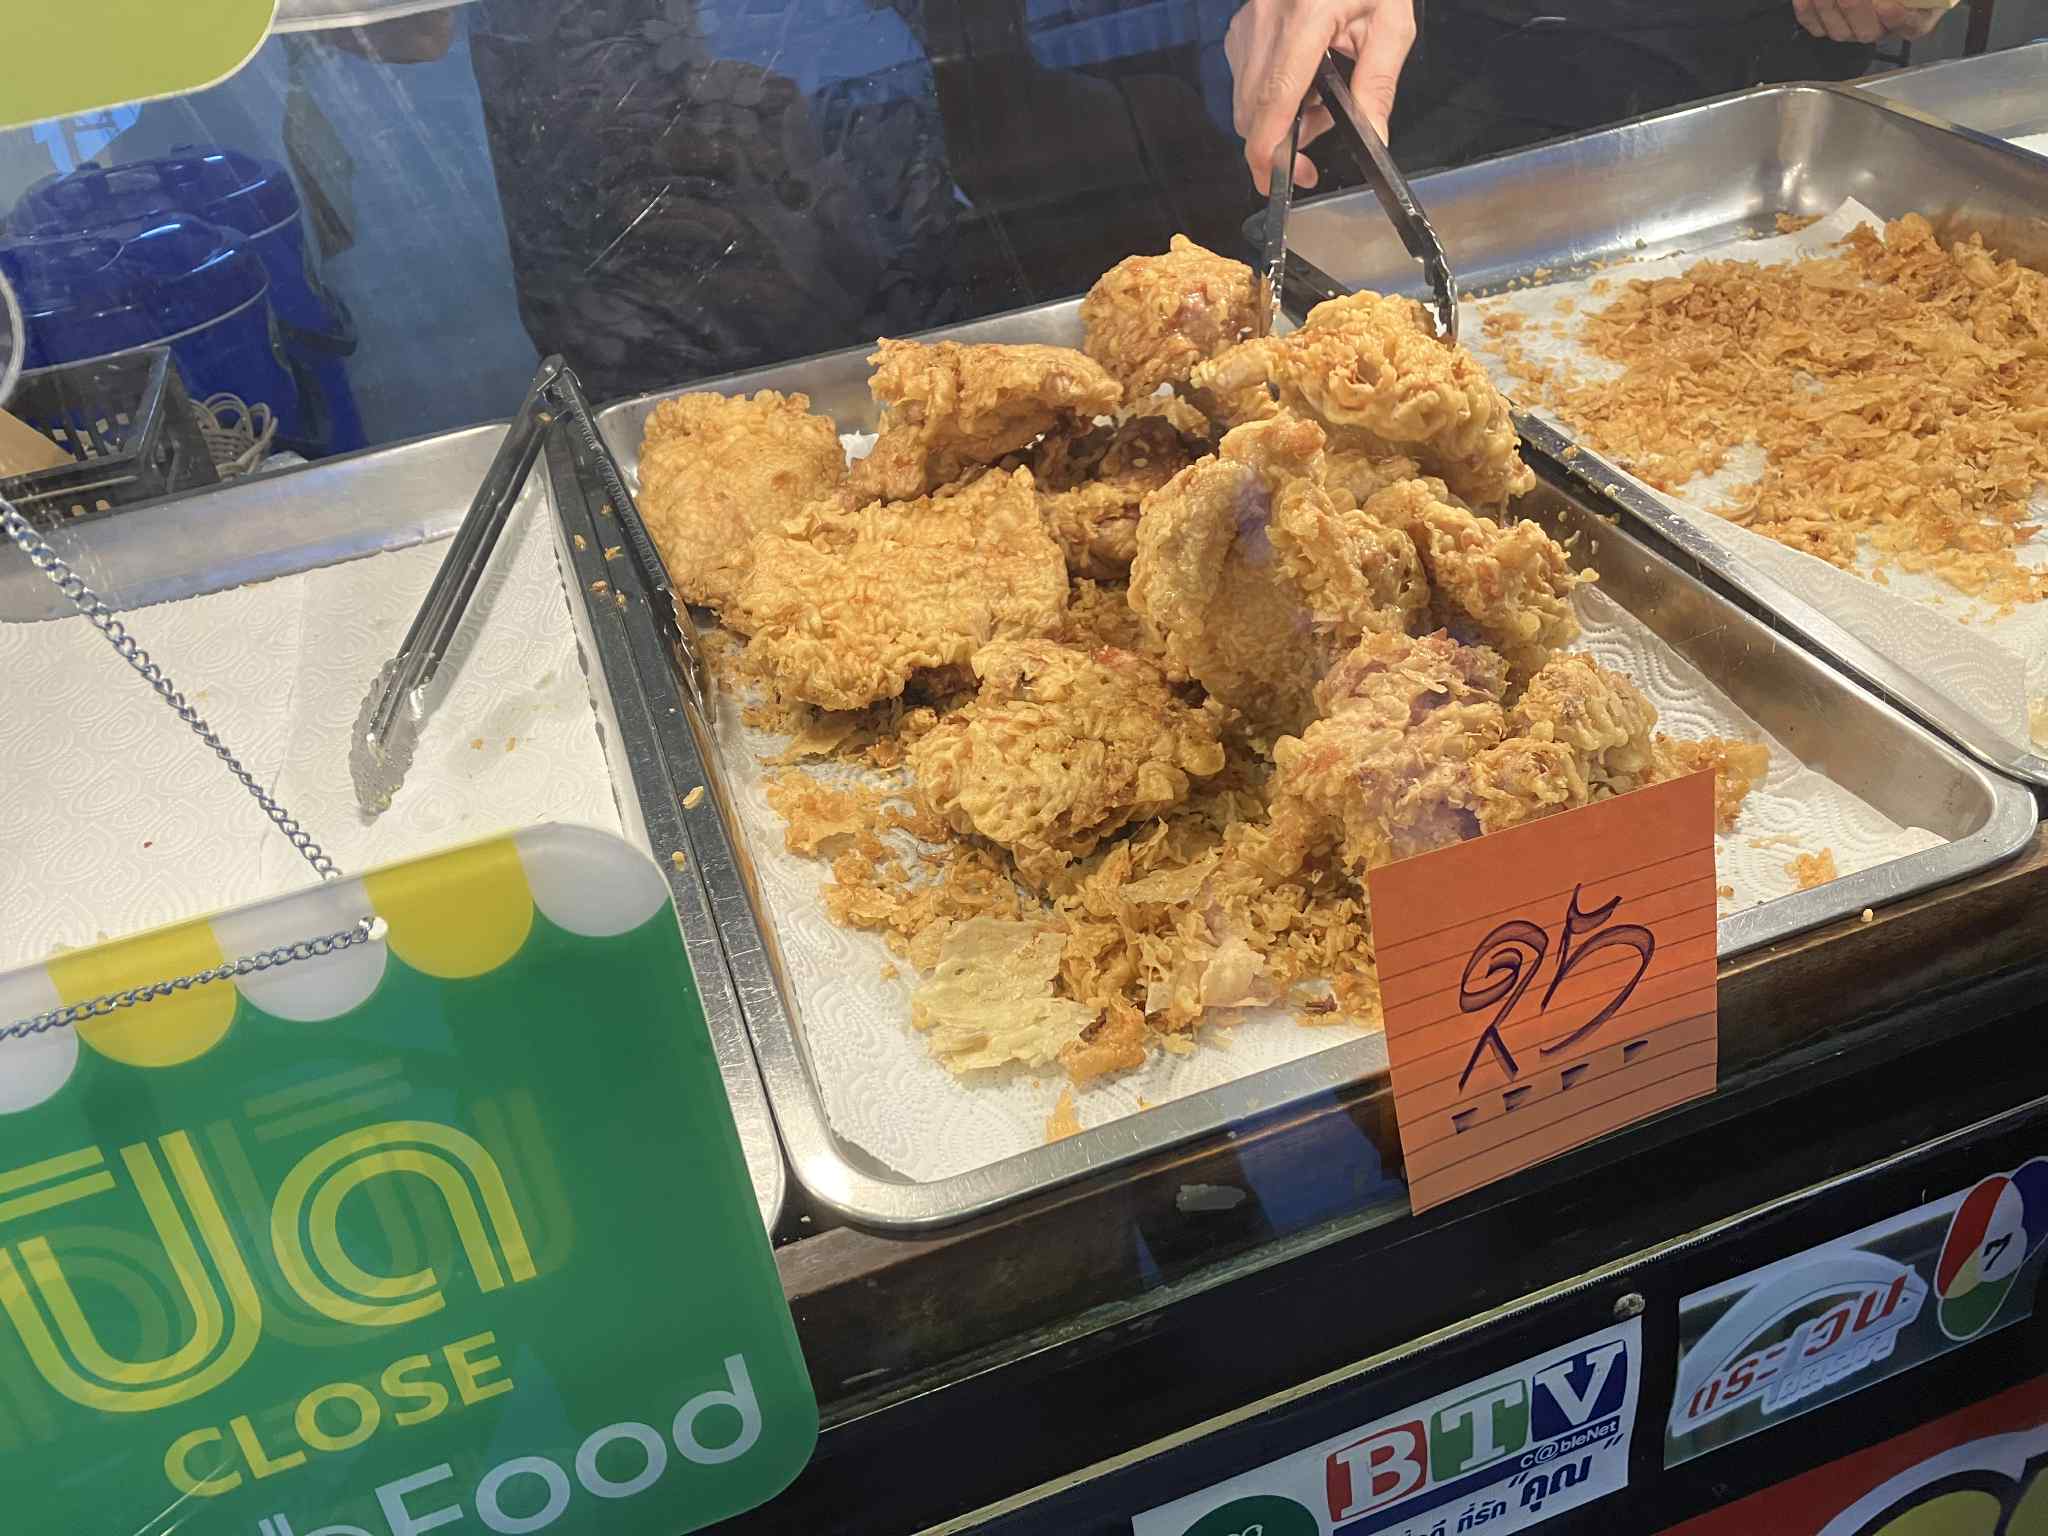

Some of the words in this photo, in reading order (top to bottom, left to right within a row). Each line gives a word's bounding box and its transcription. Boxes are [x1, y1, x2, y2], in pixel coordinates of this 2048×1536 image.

[1980, 1233, 2011, 1272] 7
[164, 1331, 514, 1497] CLOSE
[1332, 1341, 1625, 1520] BTV
